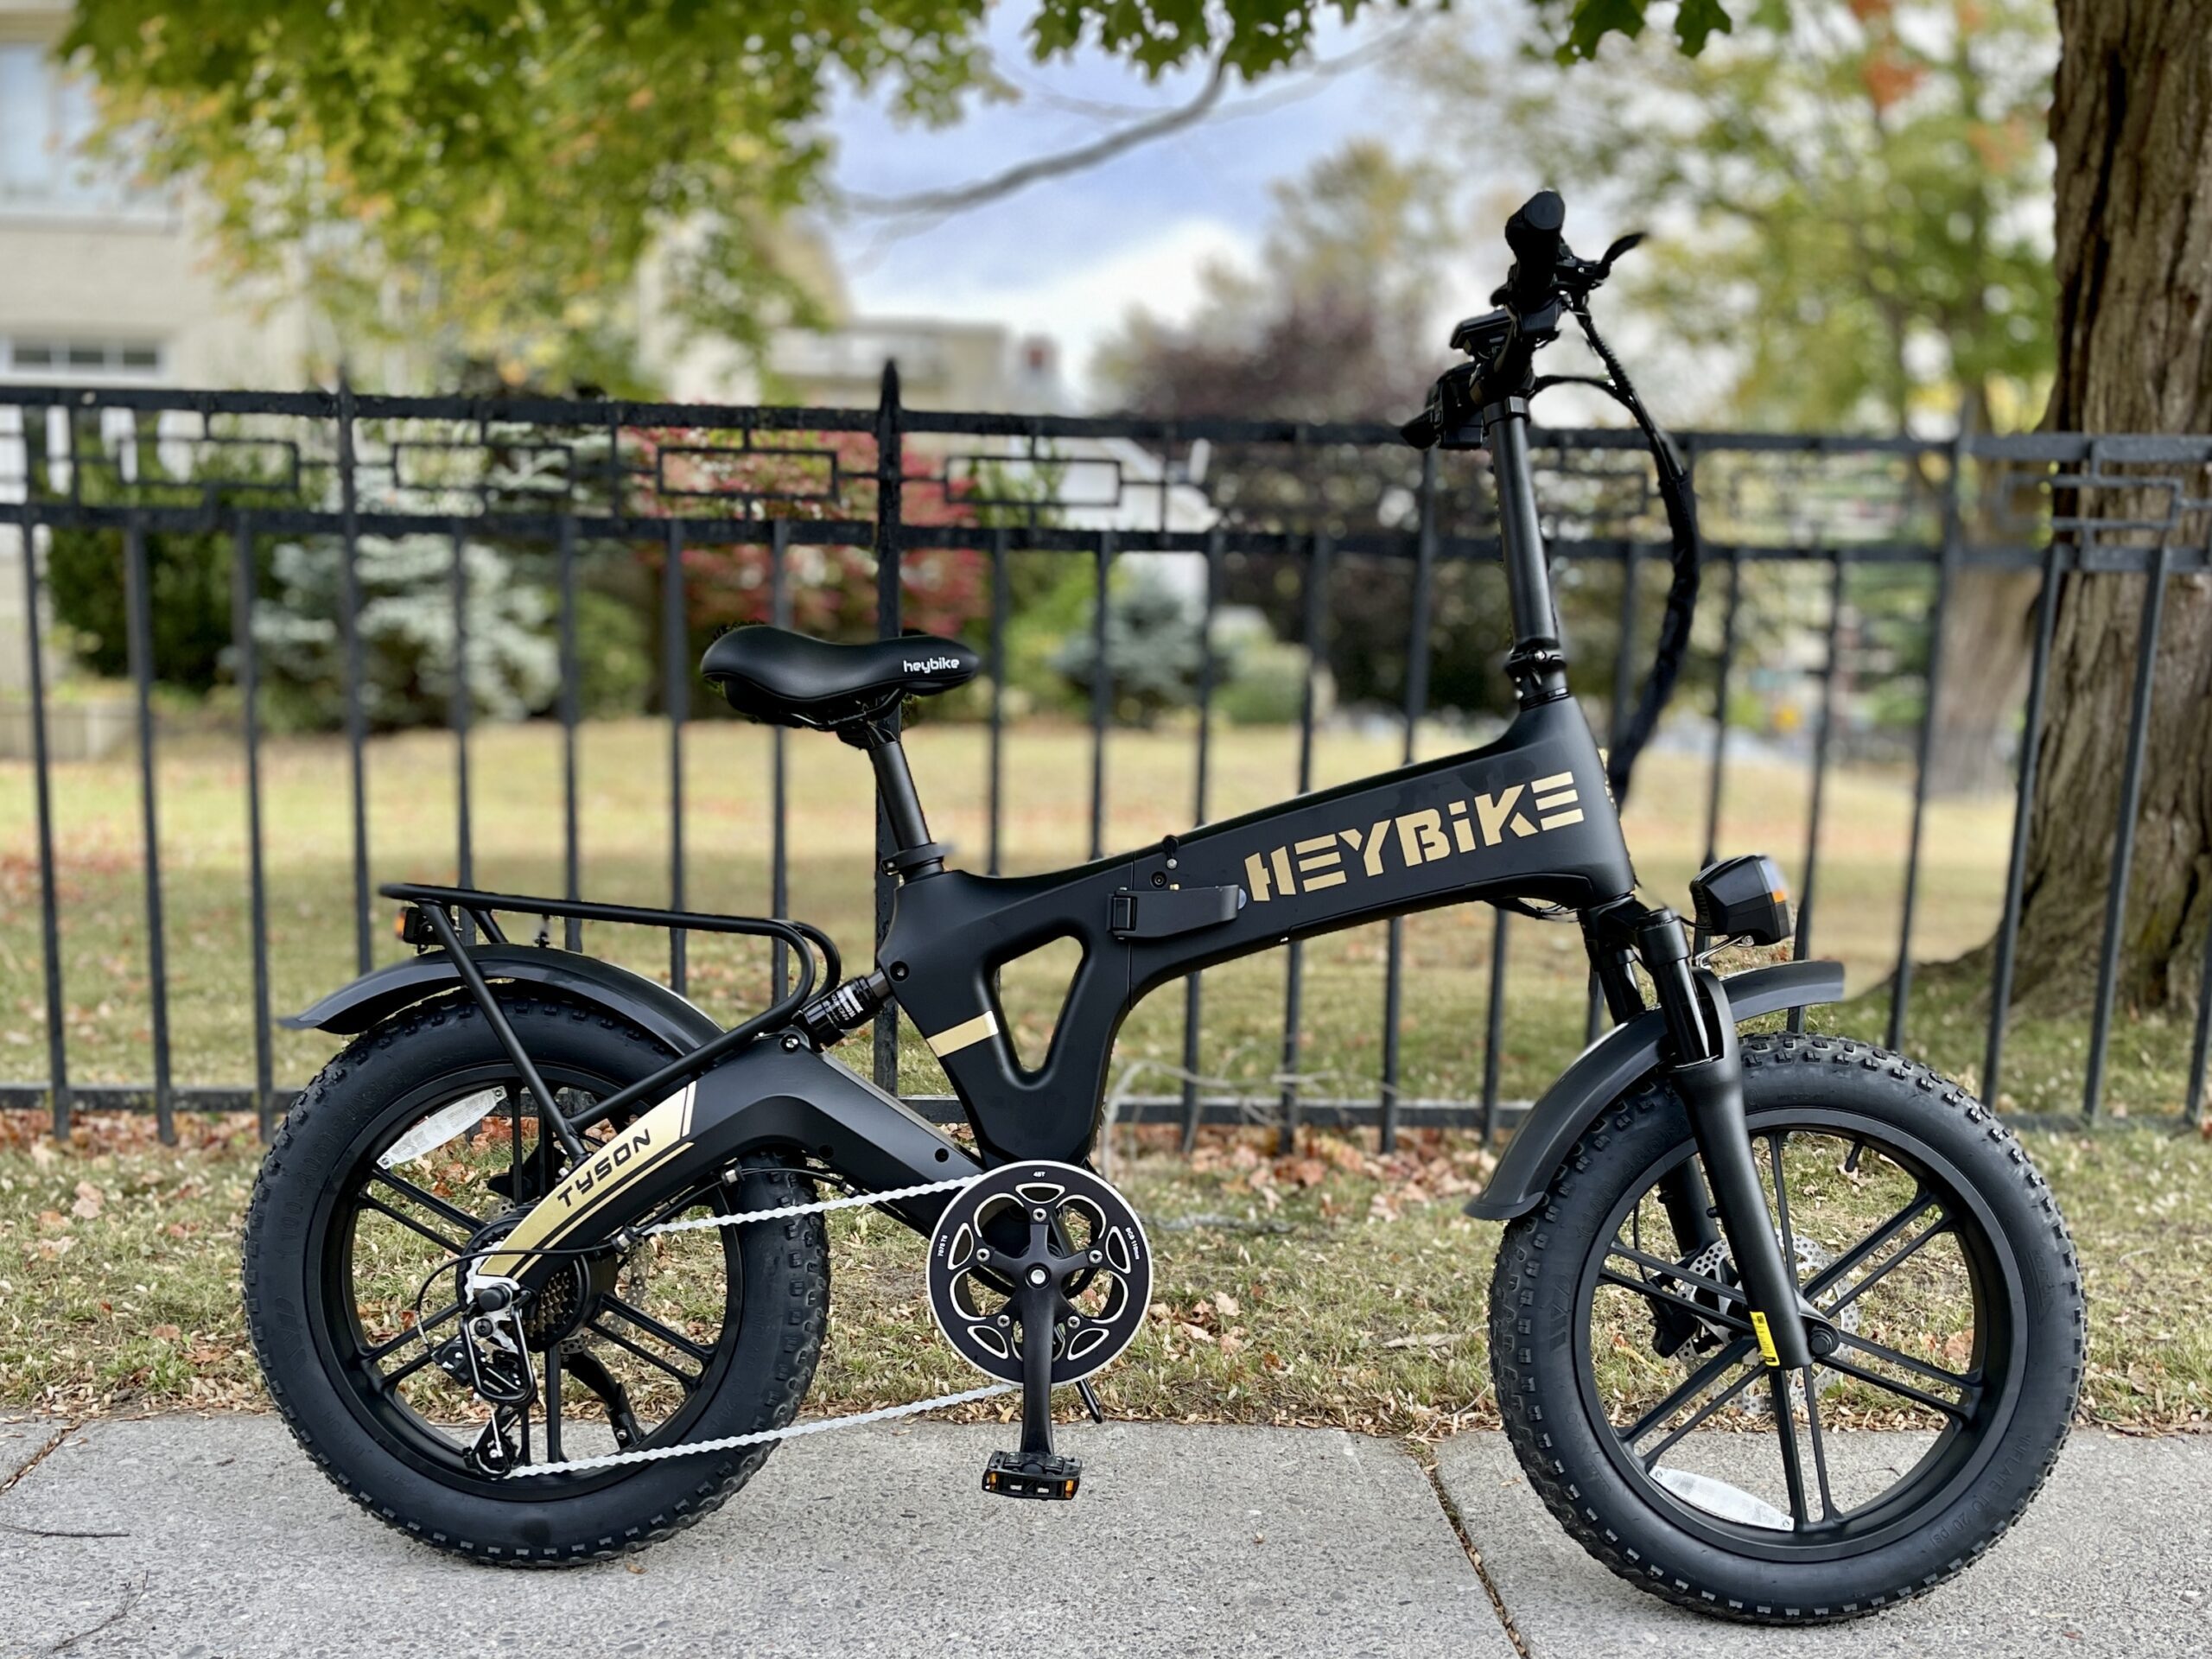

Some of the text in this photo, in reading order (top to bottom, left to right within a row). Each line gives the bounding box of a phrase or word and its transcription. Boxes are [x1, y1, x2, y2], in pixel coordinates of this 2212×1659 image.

[903, 657, 960, 674] heybike
[557, 1128, 651, 1207] TYSON
[1951, 1512, 1972, 1533] 20
